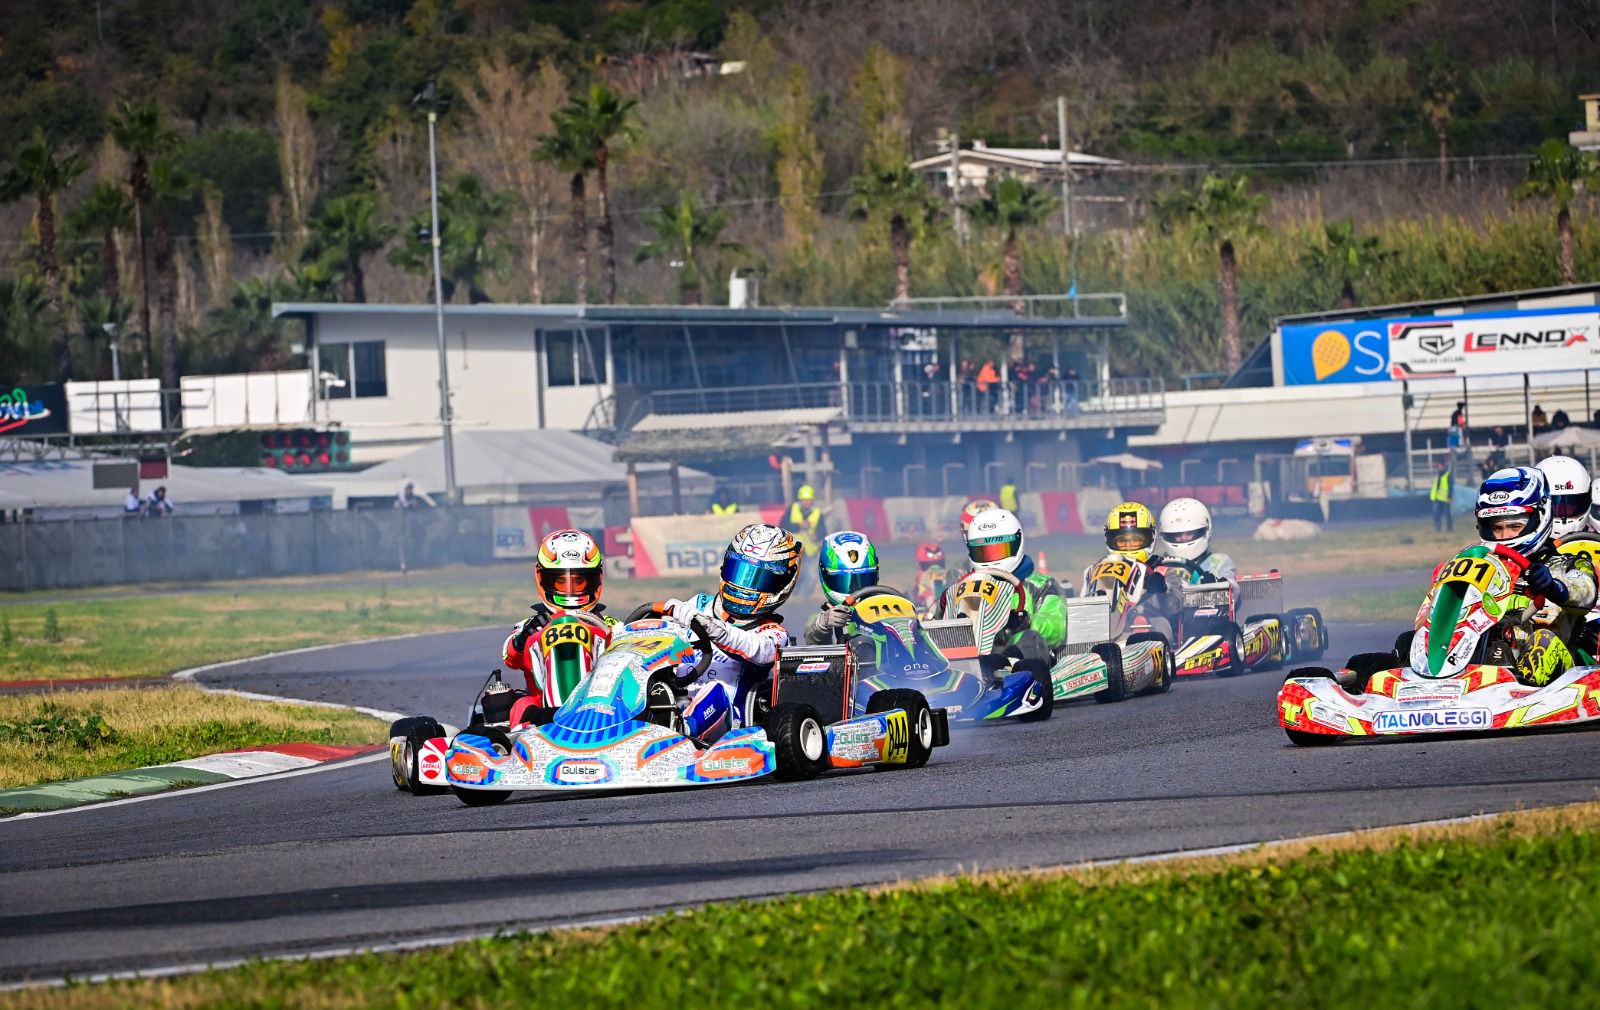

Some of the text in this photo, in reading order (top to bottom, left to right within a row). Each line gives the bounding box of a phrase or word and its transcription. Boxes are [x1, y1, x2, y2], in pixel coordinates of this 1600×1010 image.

[1463, 325, 1590, 352] LENNOX
[1354, 330, 1390, 375] S
[1094, 562, 1127, 577] 723
[1439, 558, 1491, 585] 801
[956, 580, 995, 598] 813
[545, 624, 589, 647] 840
[903, 662, 929, 672] one
[703, 704, 717, 719] HRX
[1376, 711, 1488, 729] ITALNOLEGGI
[887, 716, 909, 758] 844
[562, 765, 600, 775] Gulstar
[702, 757, 751, 770] Gulstar
